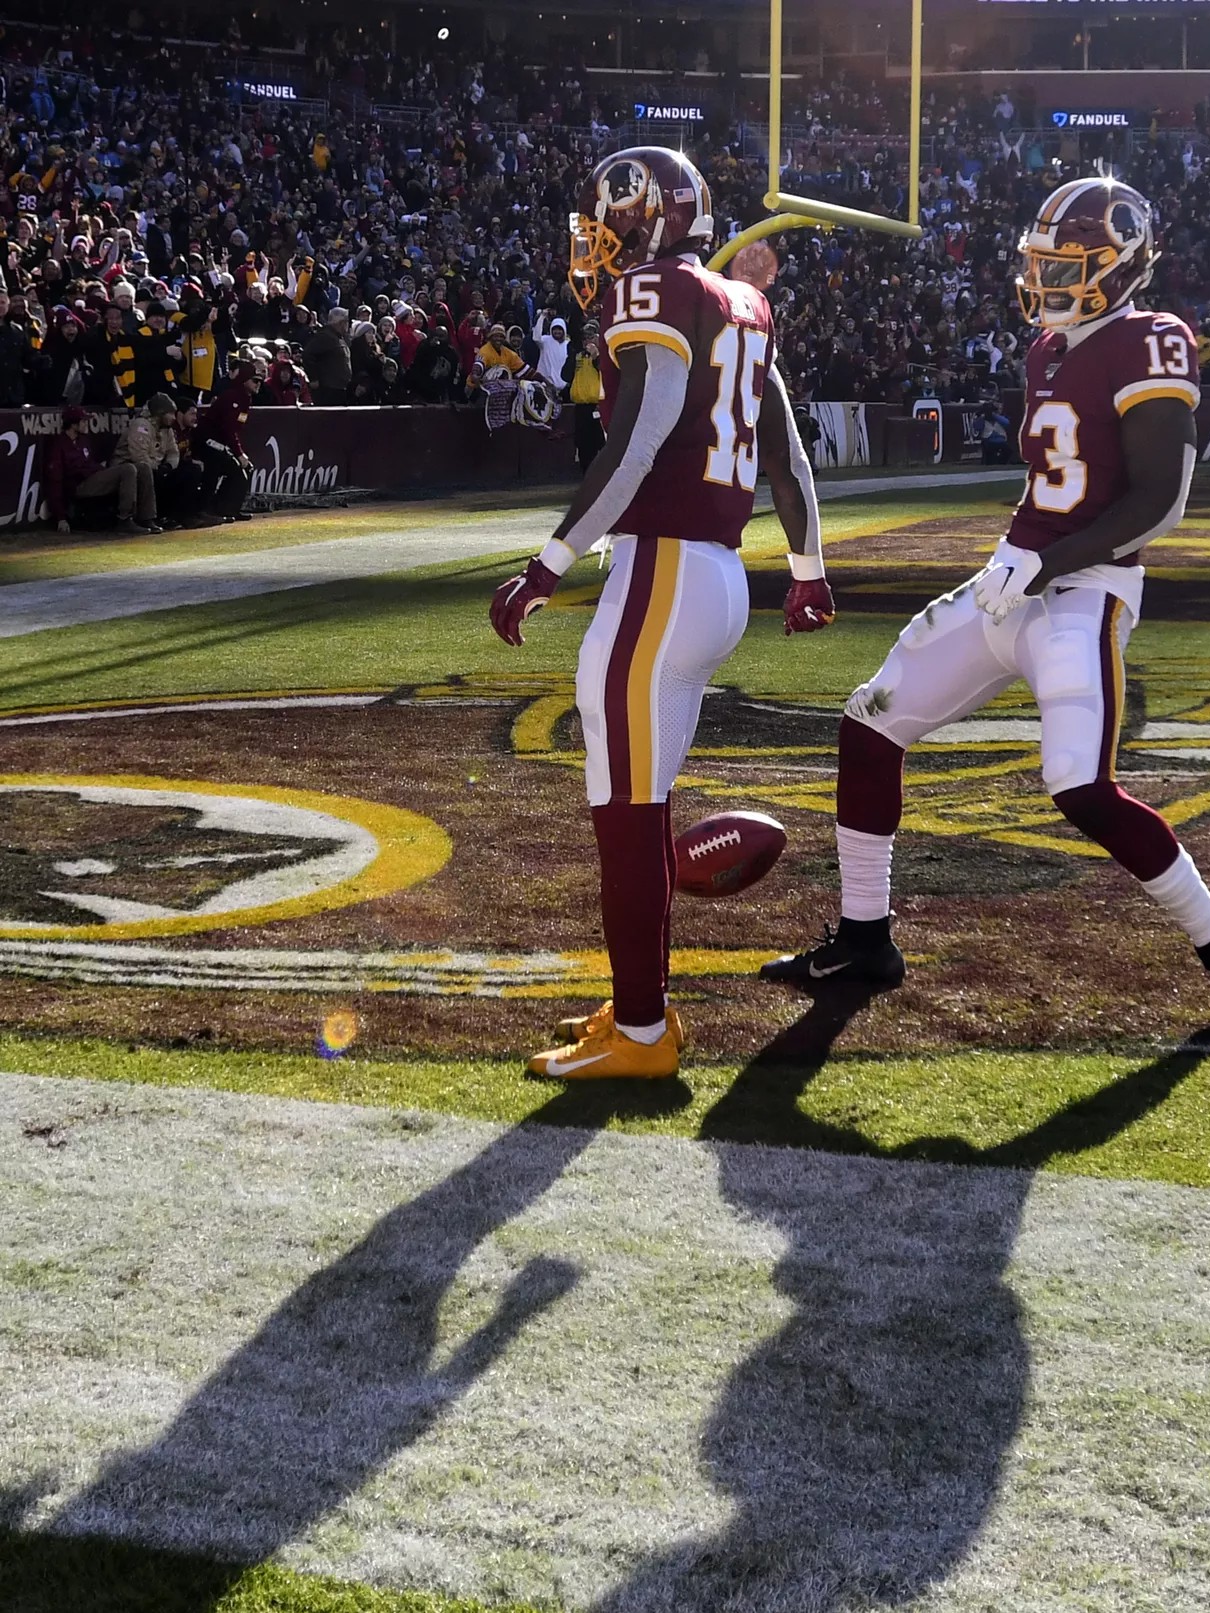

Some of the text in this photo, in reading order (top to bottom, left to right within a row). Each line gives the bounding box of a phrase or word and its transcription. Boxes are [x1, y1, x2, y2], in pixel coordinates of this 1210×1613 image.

[243, 82, 297, 99] FANDUEL
[647, 106, 704, 120] FANDUEL
[1069, 114, 1129, 126] FANDUEL
[611, 273, 662, 323] 15
[1143, 334, 1190, 376] 13
[703, 322, 768, 492] 15
[21, 412, 111, 435] WASHON
[250, 435, 339, 495] ndation
